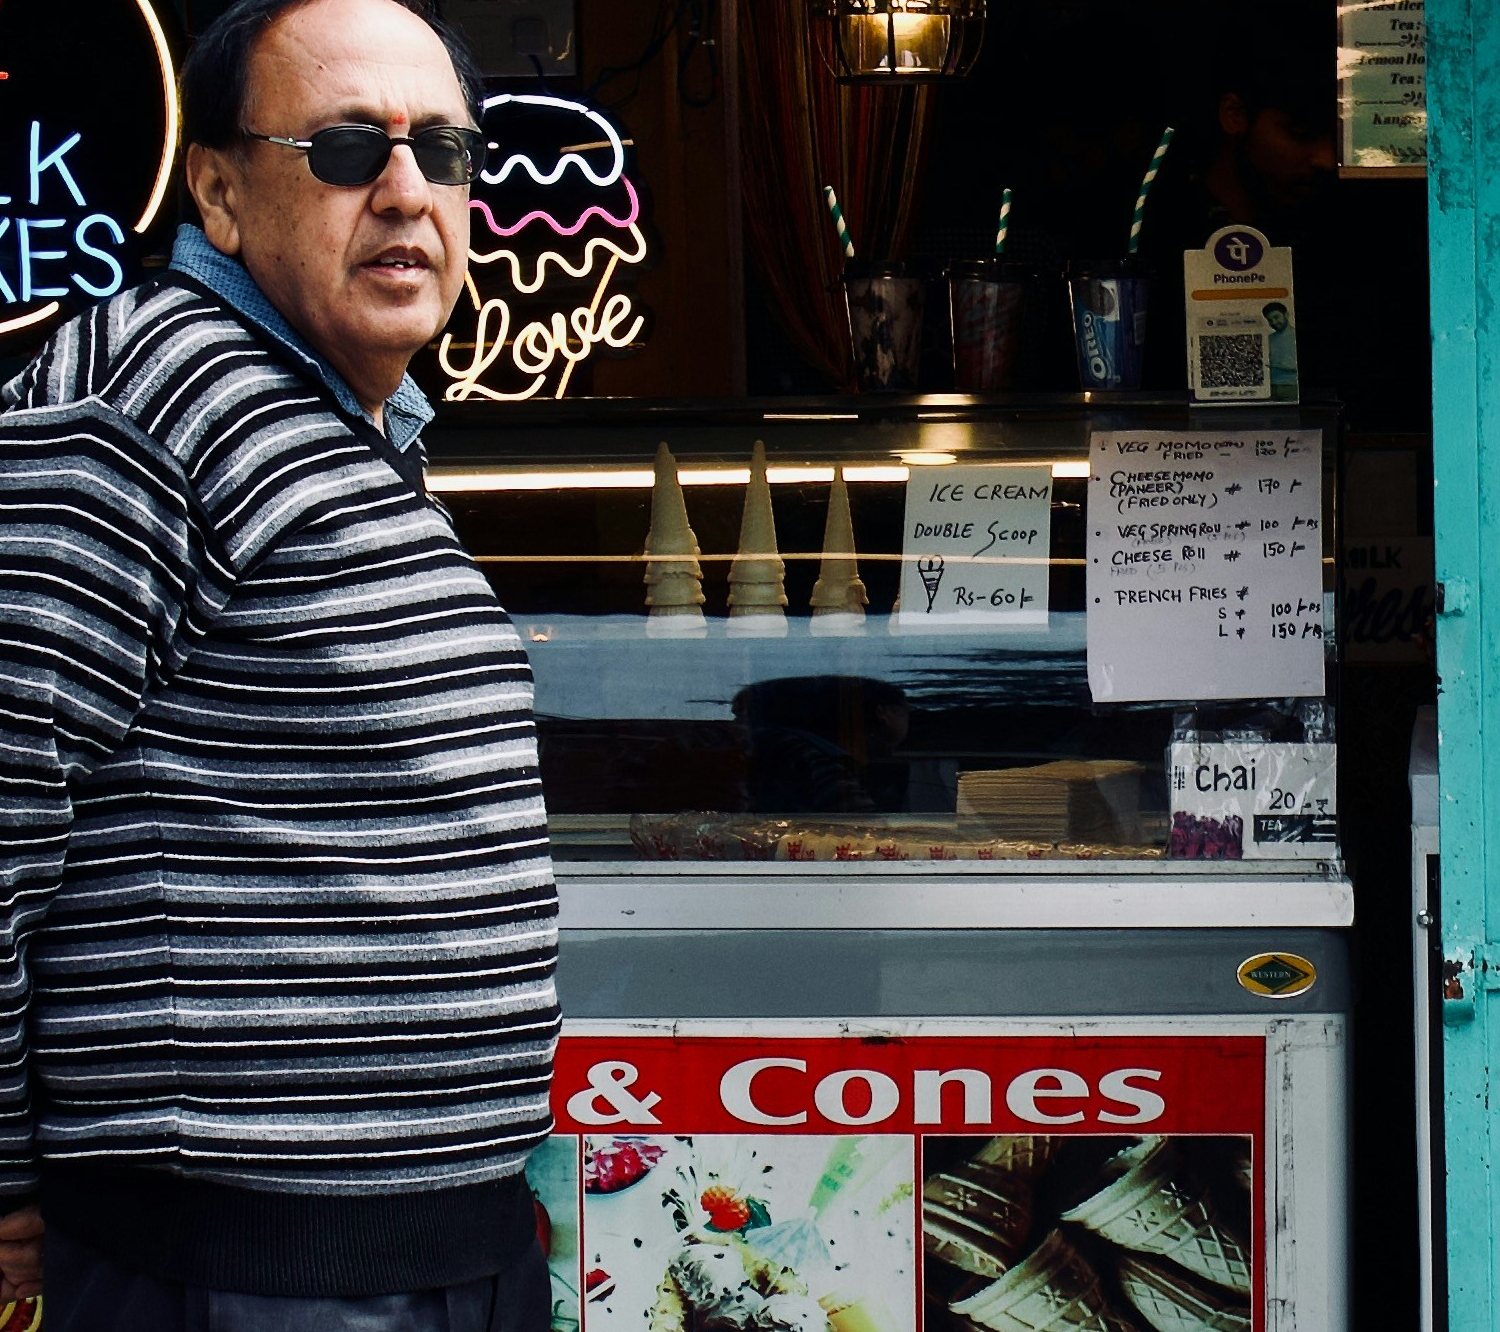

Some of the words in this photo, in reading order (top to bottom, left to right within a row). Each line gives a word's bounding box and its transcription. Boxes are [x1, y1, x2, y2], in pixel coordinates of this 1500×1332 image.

[1213, 273, 1265, 284] PhonePe
[438, 291, 646, 403] Love
[1083, 309, 1109, 381] OREO
[1116, 441, 1150, 455] VEG
[929, 483, 964, 502] ICE
[973, 484, 1049, 501] CREAM
[1259, 478, 1281, 494] 170
[913, 522, 975, 539] DOUBLE
[1117, 524, 1146, 541] VEG
[1149, 522, 1197, 539] SPRING
[1260, 519, 1280, 532] 100
[1111, 549, 1172, 567] CHEESE
[1263, 541, 1285, 558] 150
[1114, 588, 1182, 606] FRENCH
[1189, 585, 1228, 602] FRIES
[1270, 602, 1292, 620] 100
[1271, 622, 1296, 640] 150
[1195, 757, 1257, 792] Chai
[1259, 819, 1285, 832] TEA
[566, 1060, 663, 1127] &
[718, 1057, 1167, 1128] Cones
